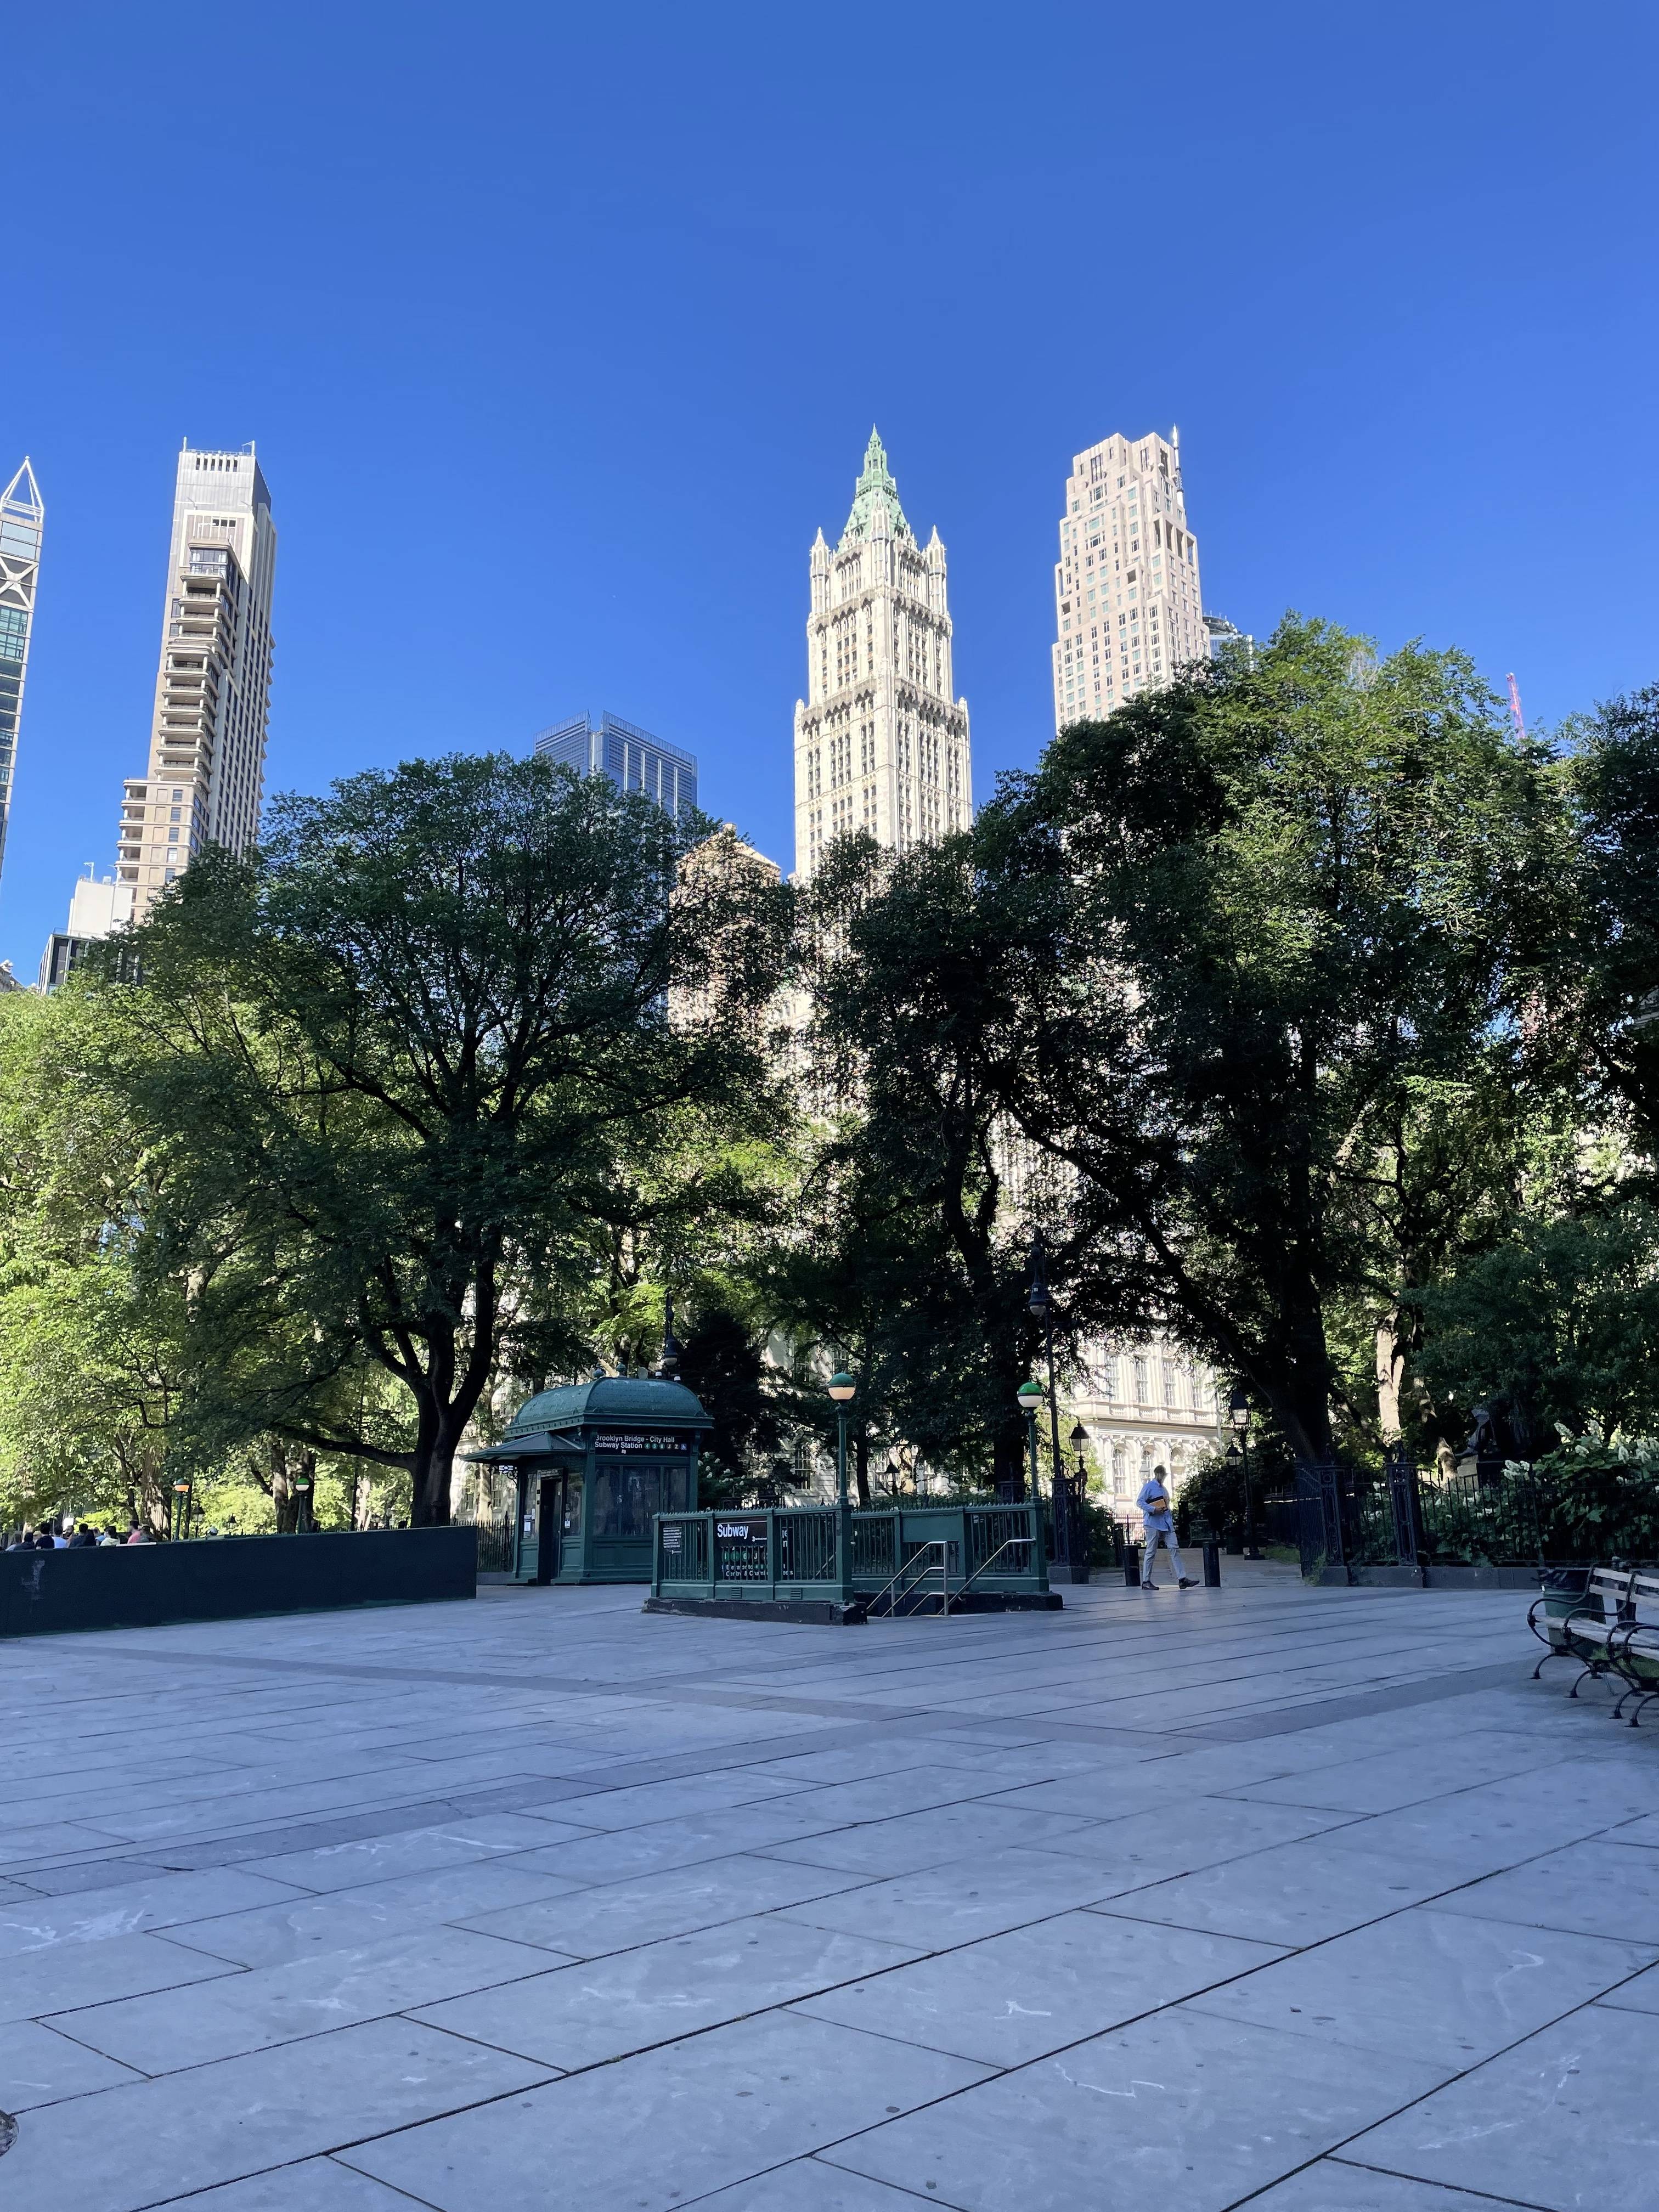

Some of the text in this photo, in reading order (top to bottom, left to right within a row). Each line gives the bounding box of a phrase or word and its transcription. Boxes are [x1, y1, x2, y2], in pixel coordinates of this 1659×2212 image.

[596, 1435, 623, 1443] Brooklyn
[624, 1435, 645, 1443] Bridge
[650, 1436, 662, 1444] City
[595, 1441, 619, 1449] Subway
[717, 1523, 749, 1539] Subway
